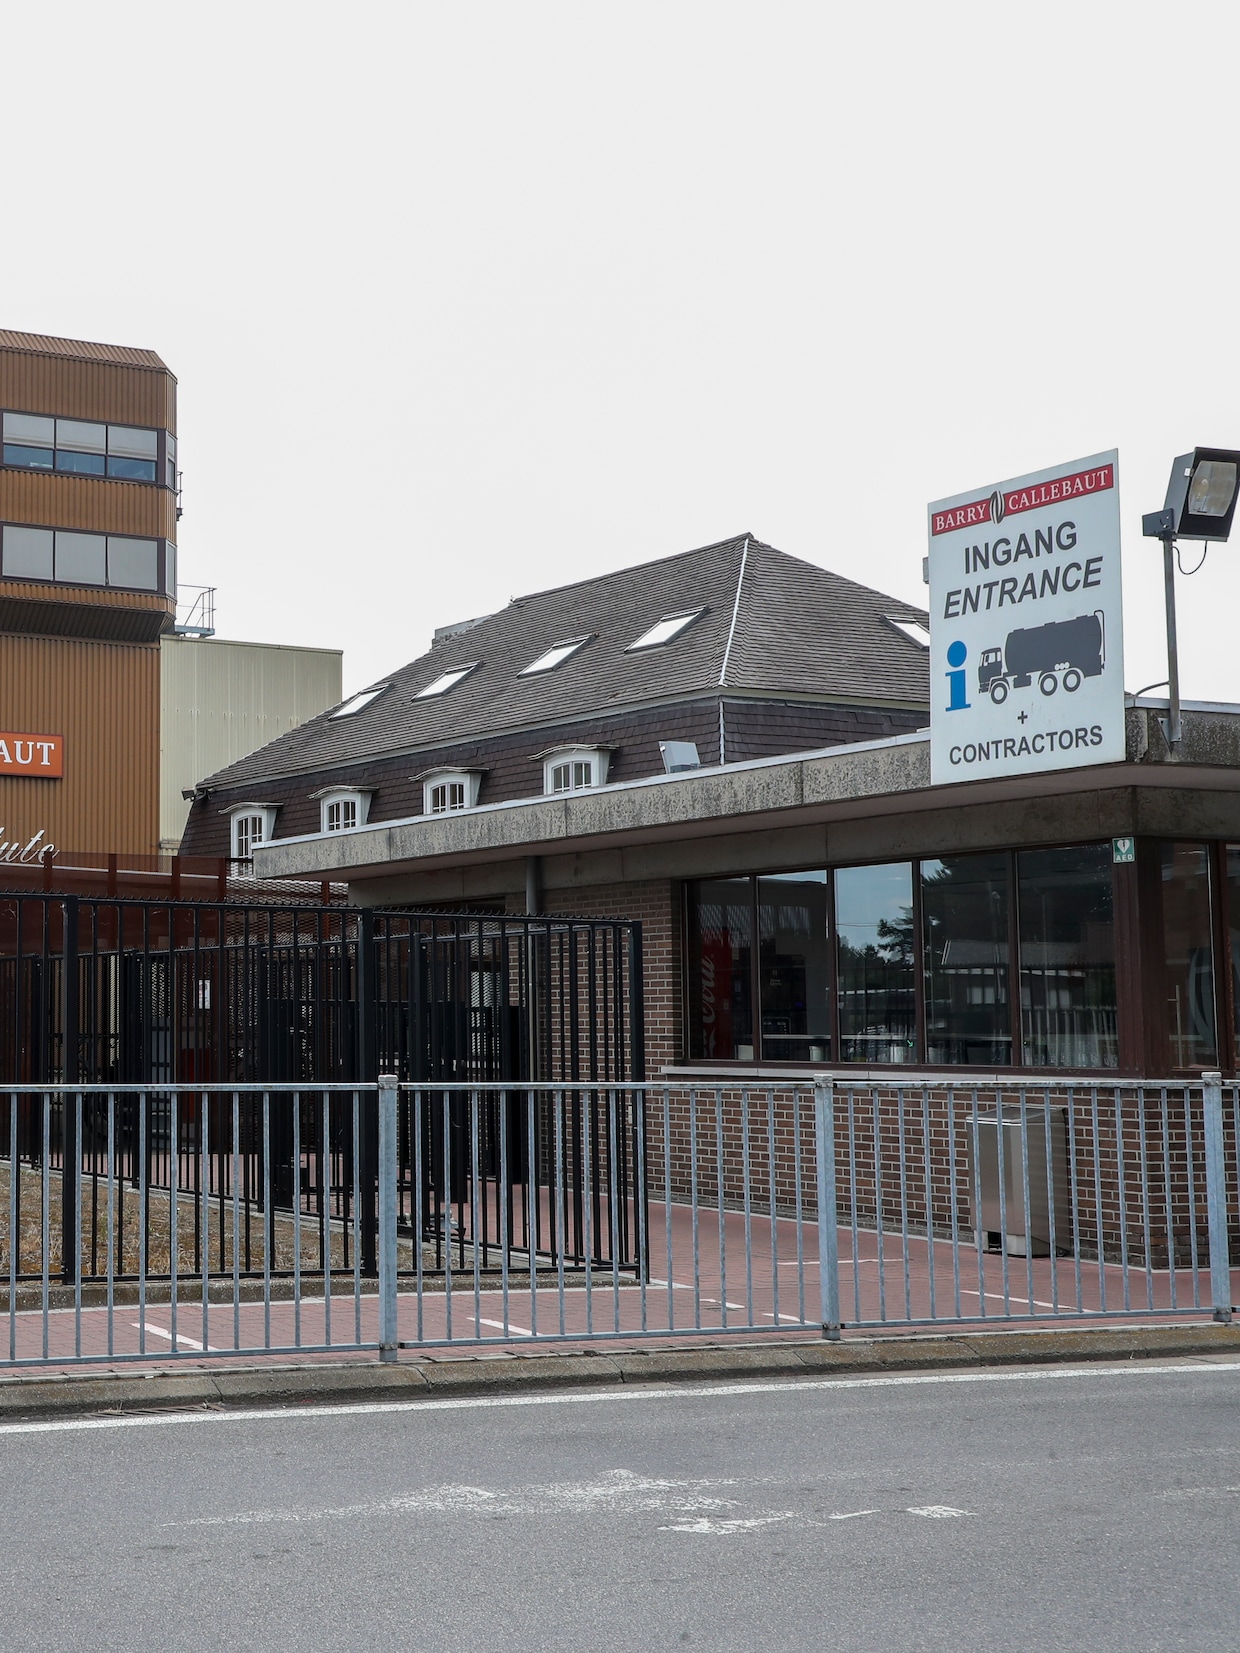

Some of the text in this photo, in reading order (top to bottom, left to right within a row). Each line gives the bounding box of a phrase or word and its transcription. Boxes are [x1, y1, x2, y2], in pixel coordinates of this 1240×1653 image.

[935, 469, 1109, 532] BARRY CALLEBAUT
[964, 520, 1078, 575] INGANG
[943, 556, 1104, 619] ENTRANCE
[949, 724, 1104, 766] CONTRACTORS
[1116, 853, 1133, 861] AED
